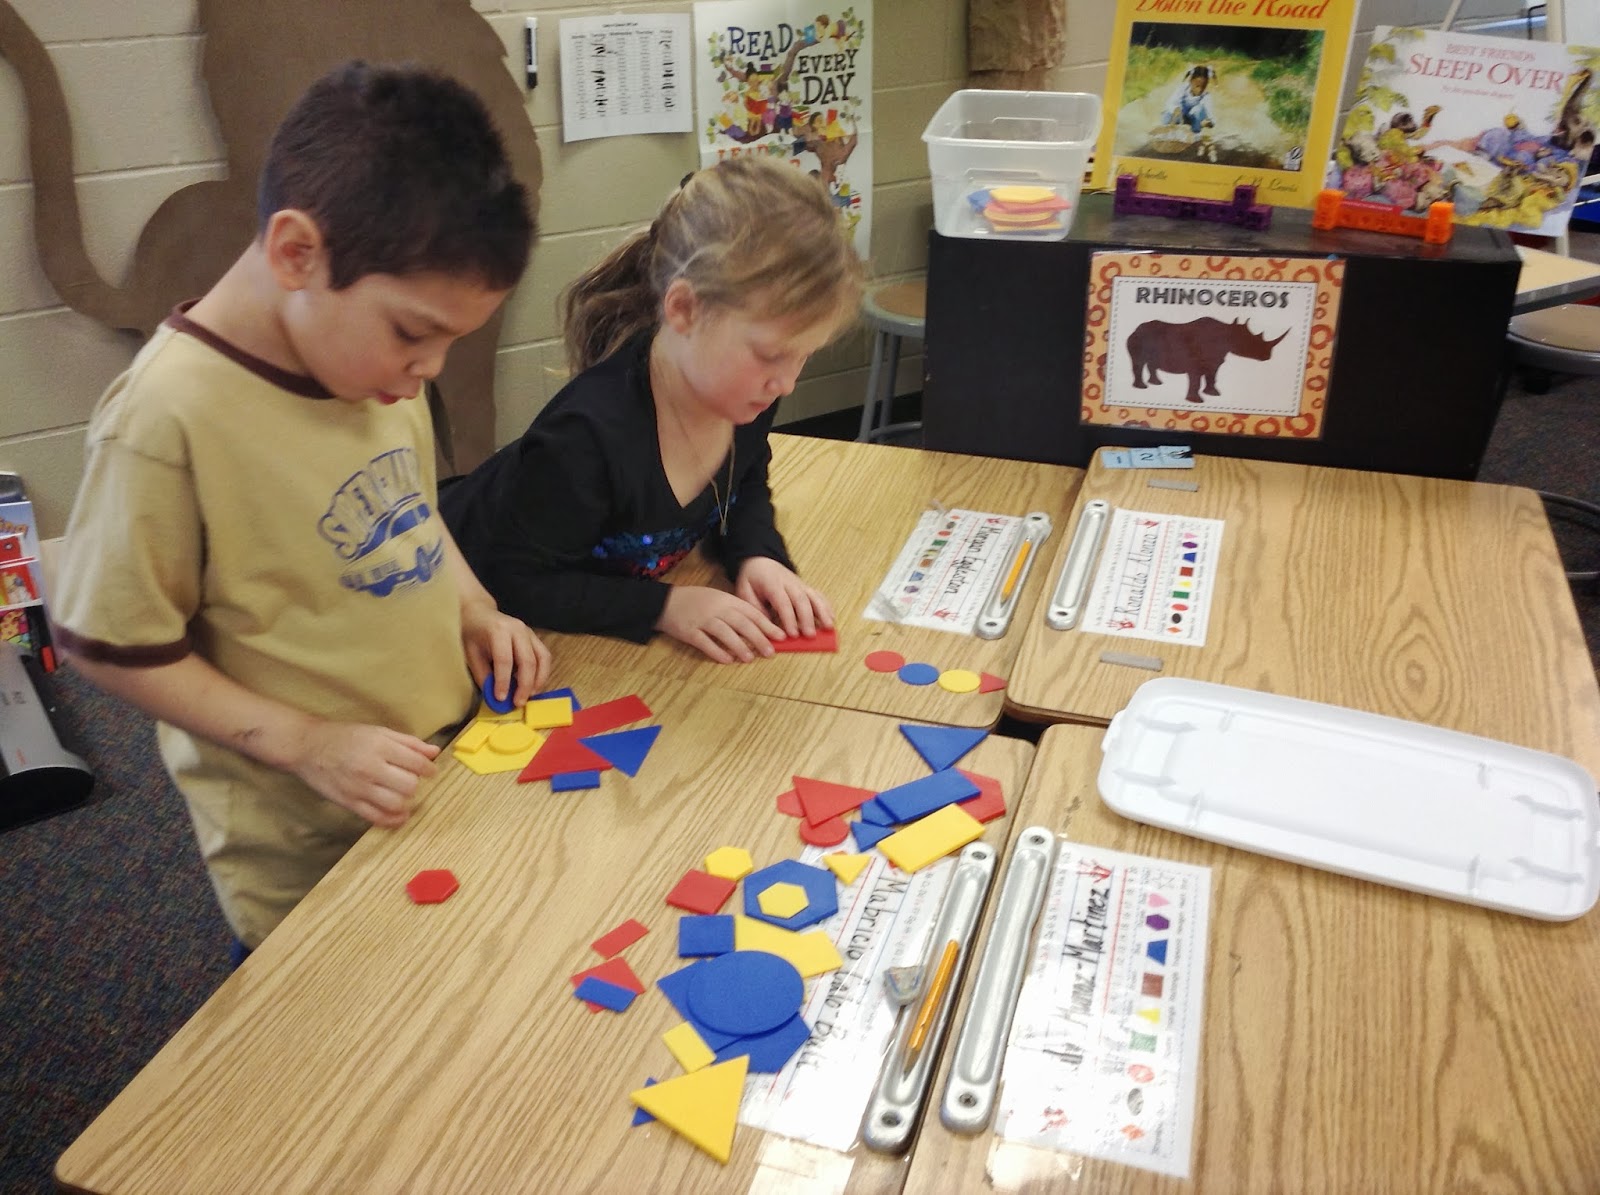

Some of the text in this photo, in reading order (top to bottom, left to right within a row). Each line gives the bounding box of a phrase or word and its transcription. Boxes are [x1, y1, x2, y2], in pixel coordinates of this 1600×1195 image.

[1206, 0, 1246, 15] the
[1252, 0, 1329, 19] Road
[727, 23, 793, 60] READ
[798, 48, 859, 74] EVERY
[1406, 53, 1483, 81] SLEEP
[1487, 62, 1565, 95] OVER
[802, 72, 855, 105] DAY
[1136, 286, 1290, 309] RHINOCEROS
[1140, 452, 1154, 461] 2
